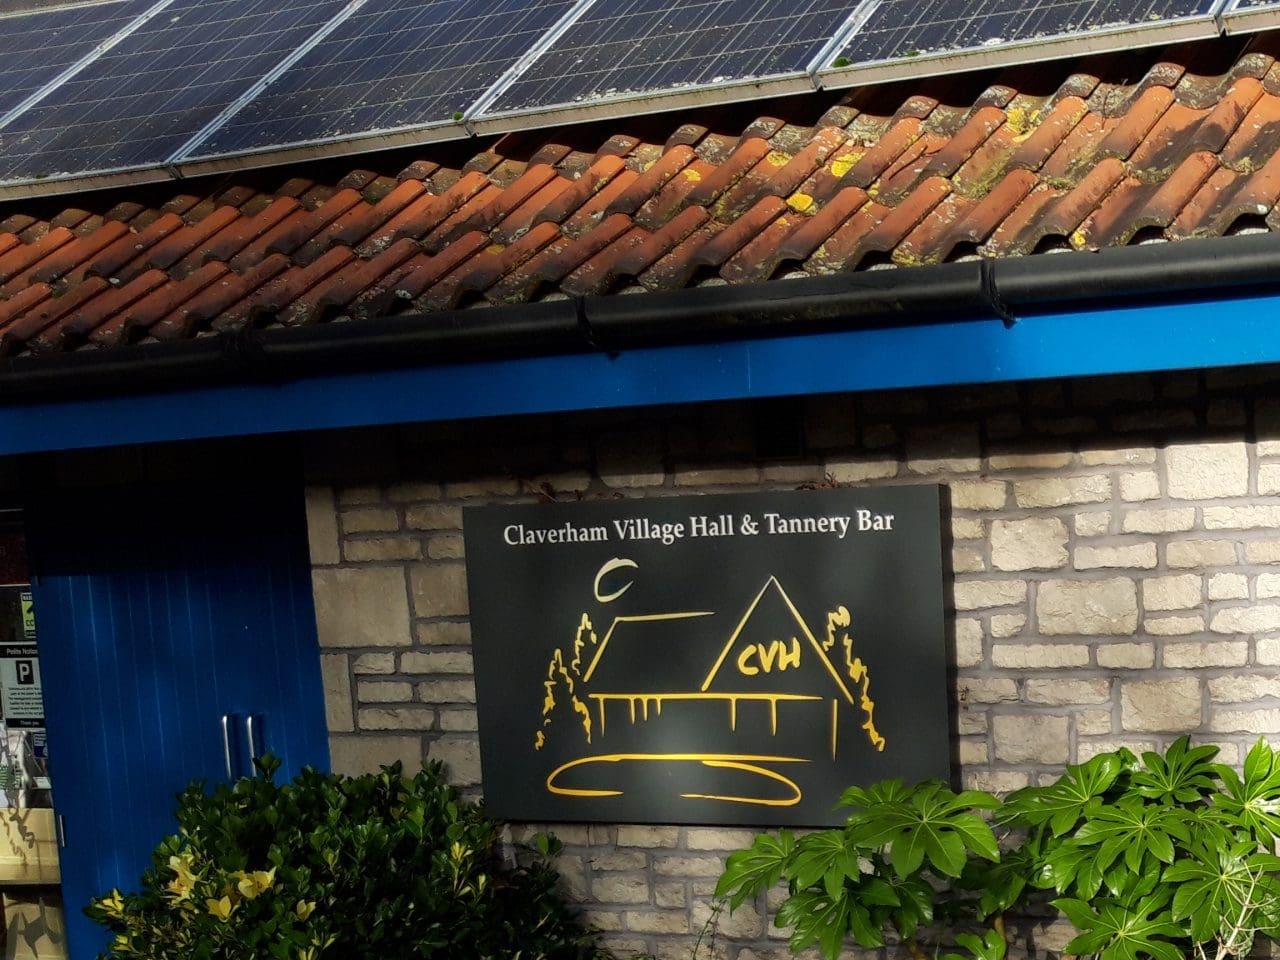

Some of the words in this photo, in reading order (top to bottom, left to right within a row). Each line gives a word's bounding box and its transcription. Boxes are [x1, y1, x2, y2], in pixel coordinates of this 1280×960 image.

[503, 522, 608, 546] Claverham
[612, 517, 685, 545] Village
[689, 514, 734, 538] Hall
[740, 513, 759, 535] &
[764, 510, 851, 539] Tannery
[856, 508, 894, 532] Bar
[19, 663, 30, 682] P
[737, 637, 801, 676] CVH
